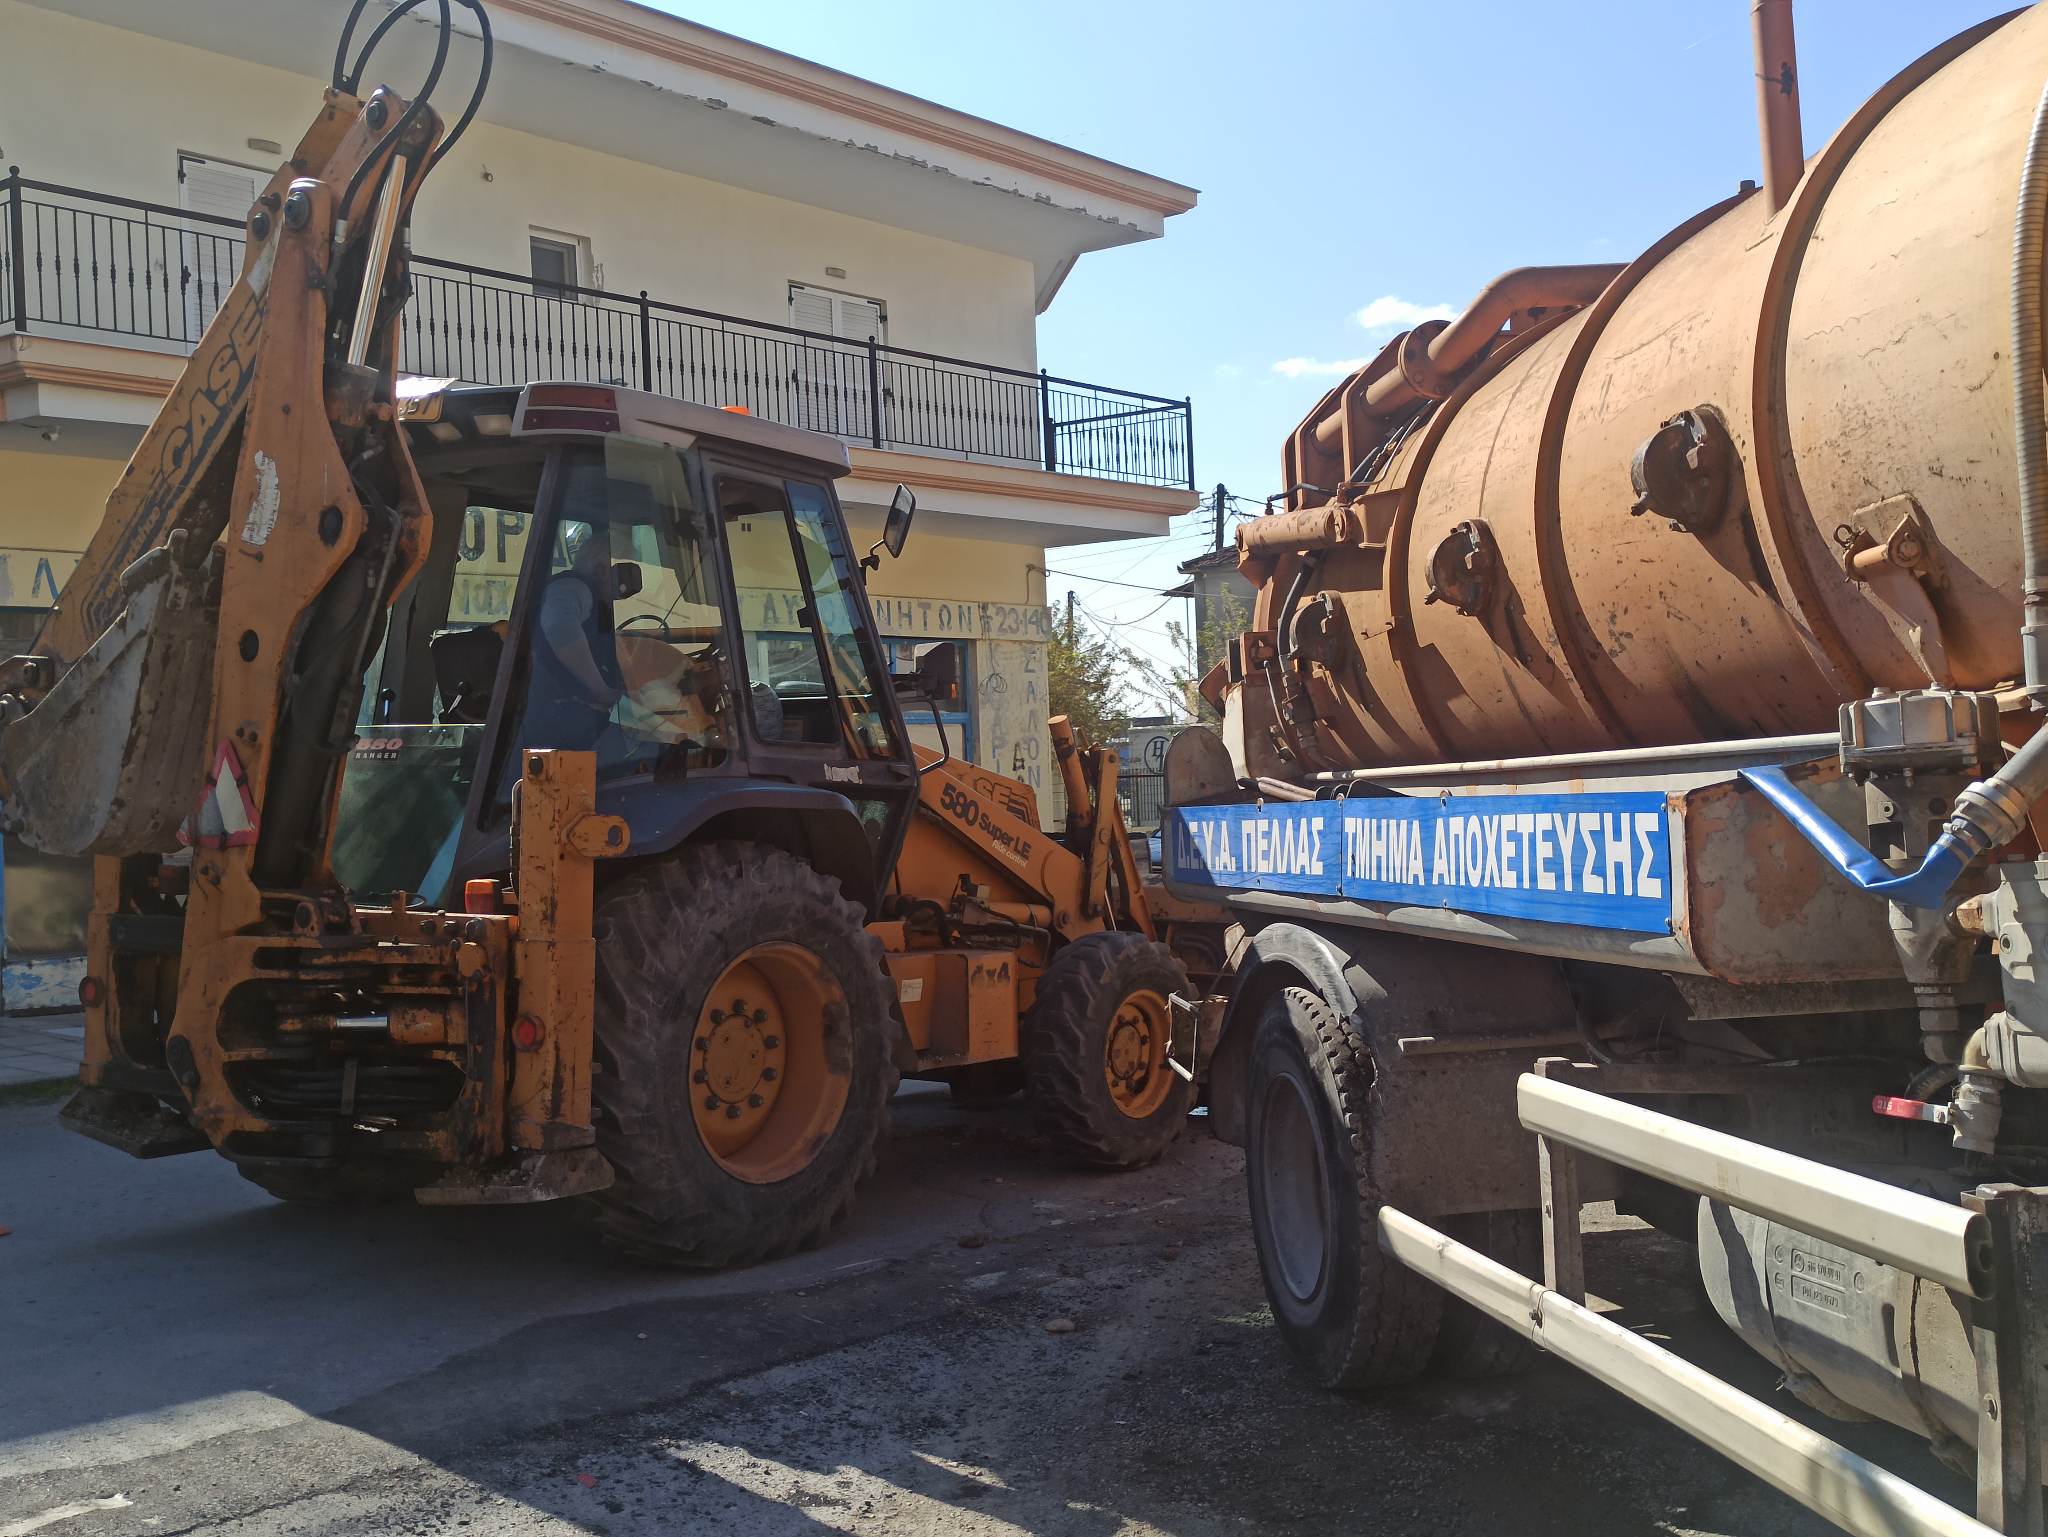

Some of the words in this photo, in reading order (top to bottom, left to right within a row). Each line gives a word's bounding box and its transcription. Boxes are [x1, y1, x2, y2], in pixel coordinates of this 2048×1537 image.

[161, 295, 263, 484] CASE
[940, 782, 980, 827] 580
[980, 814, 1014, 846] Super
[1014, 836, 1033, 860] LE
[992, 840, 1007, 855] Ride
[1178, 820, 1236, 872] Δ.Ε.Υ.Α.
[1241, 817, 1324, 875] ΠΕΛΛΑΣ
[1345, 818, 1424, 885] ΤΜΗΜΑ
[1432, 813, 1662, 899] ΑΠΟΧΕΤΕΥΣΗΣ
